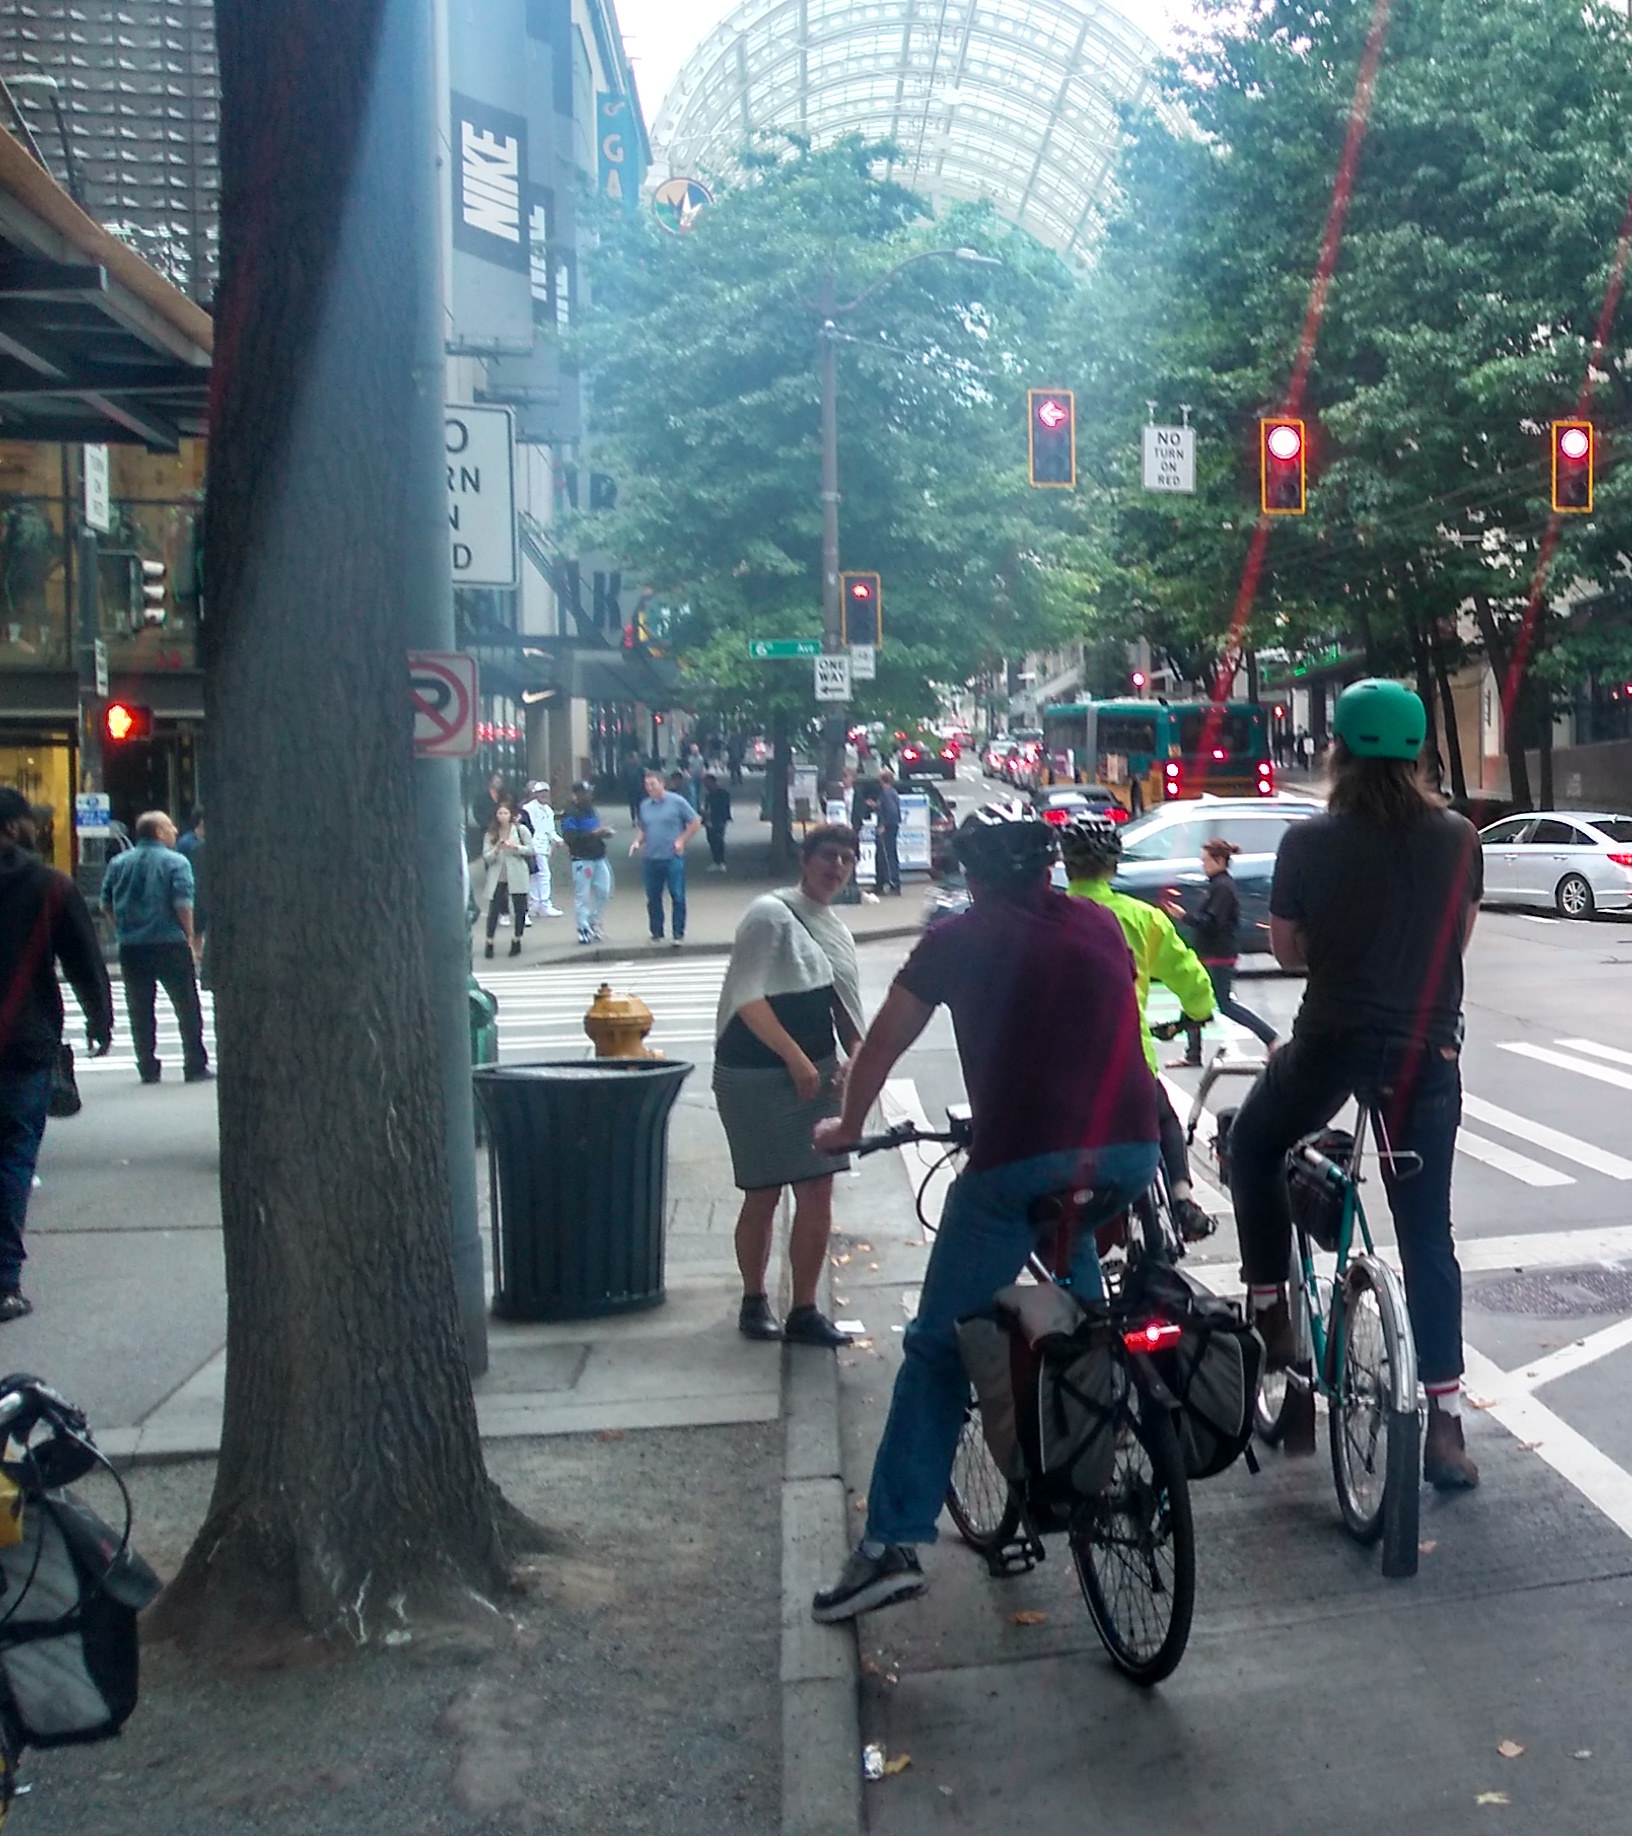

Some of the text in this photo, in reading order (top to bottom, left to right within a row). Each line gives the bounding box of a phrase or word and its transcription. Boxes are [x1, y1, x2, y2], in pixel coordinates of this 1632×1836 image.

[461, 120, 520, 243] NIKE
[1157, 432, 1181, 446] NO
[1154, 447, 1184, 459] TURN
[1160, 461, 1177, 472] ON
[1157, 474, 1181, 486] RED
[819, 660, 843, 670] ONE
[819, 672, 844, 682] WAY
